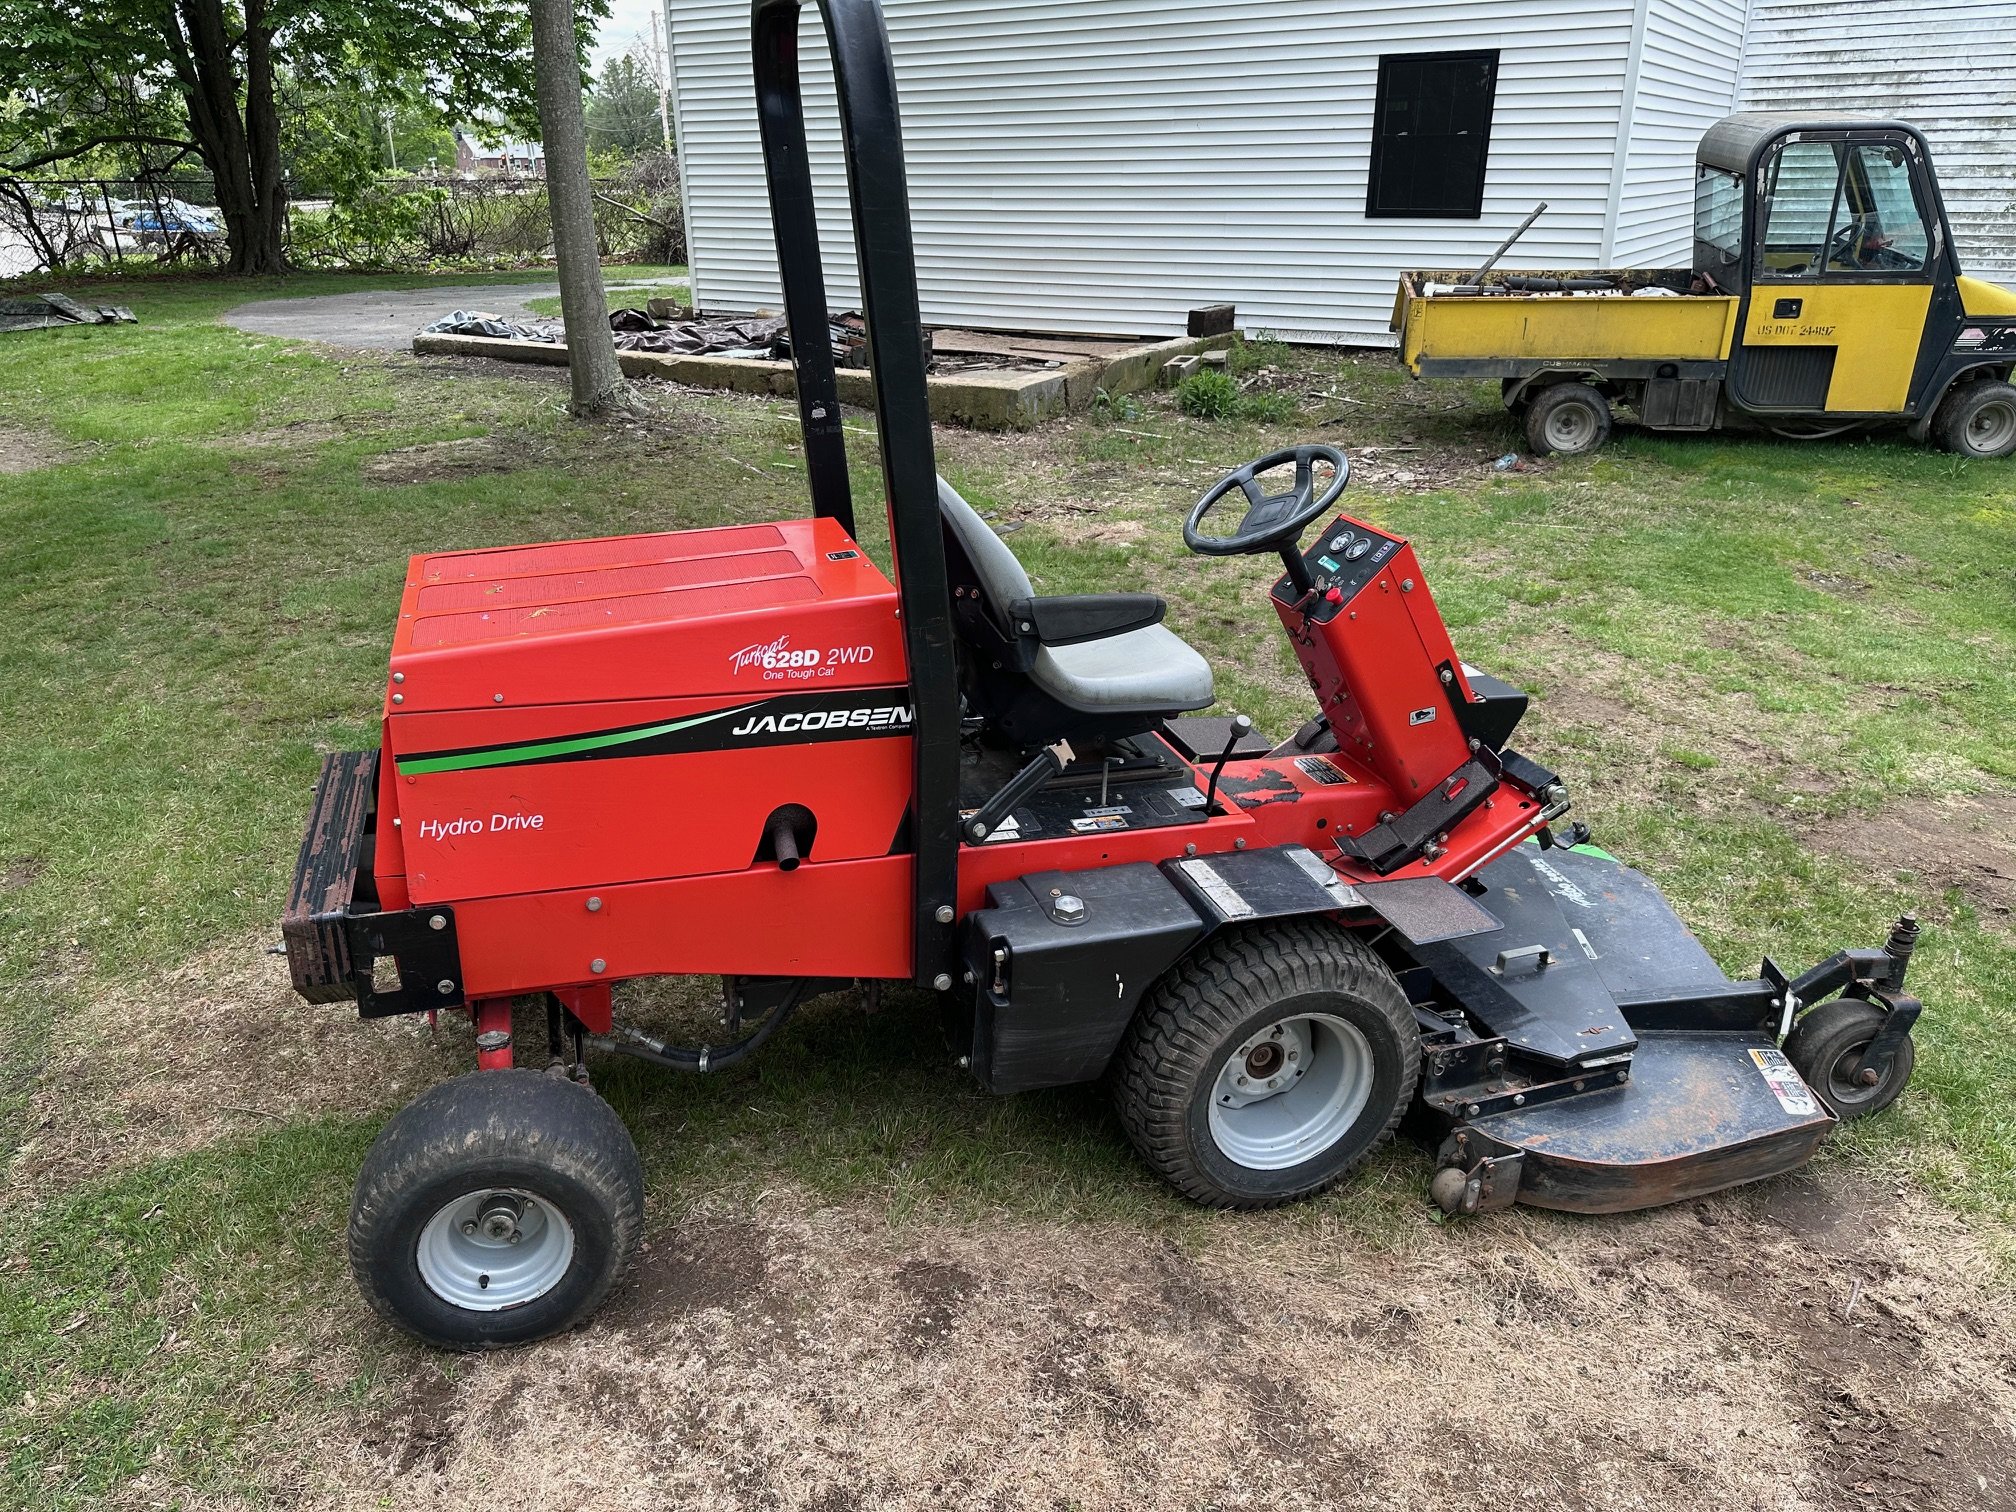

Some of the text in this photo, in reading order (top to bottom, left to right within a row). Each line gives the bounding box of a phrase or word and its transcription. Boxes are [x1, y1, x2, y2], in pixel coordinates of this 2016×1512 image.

[1757, 325, 1773, 335] US
[1774, 325, 1797, 335] DOT
[728, 634, 790, 676] Turfcat
[762, 645, 874, 669] 628D 2WD
[763, 667, 835, 680] One Tough Cat
[732, 706, 913, 736] JACOBSEN
[419, 812, 544, 841] Hydro Drive
